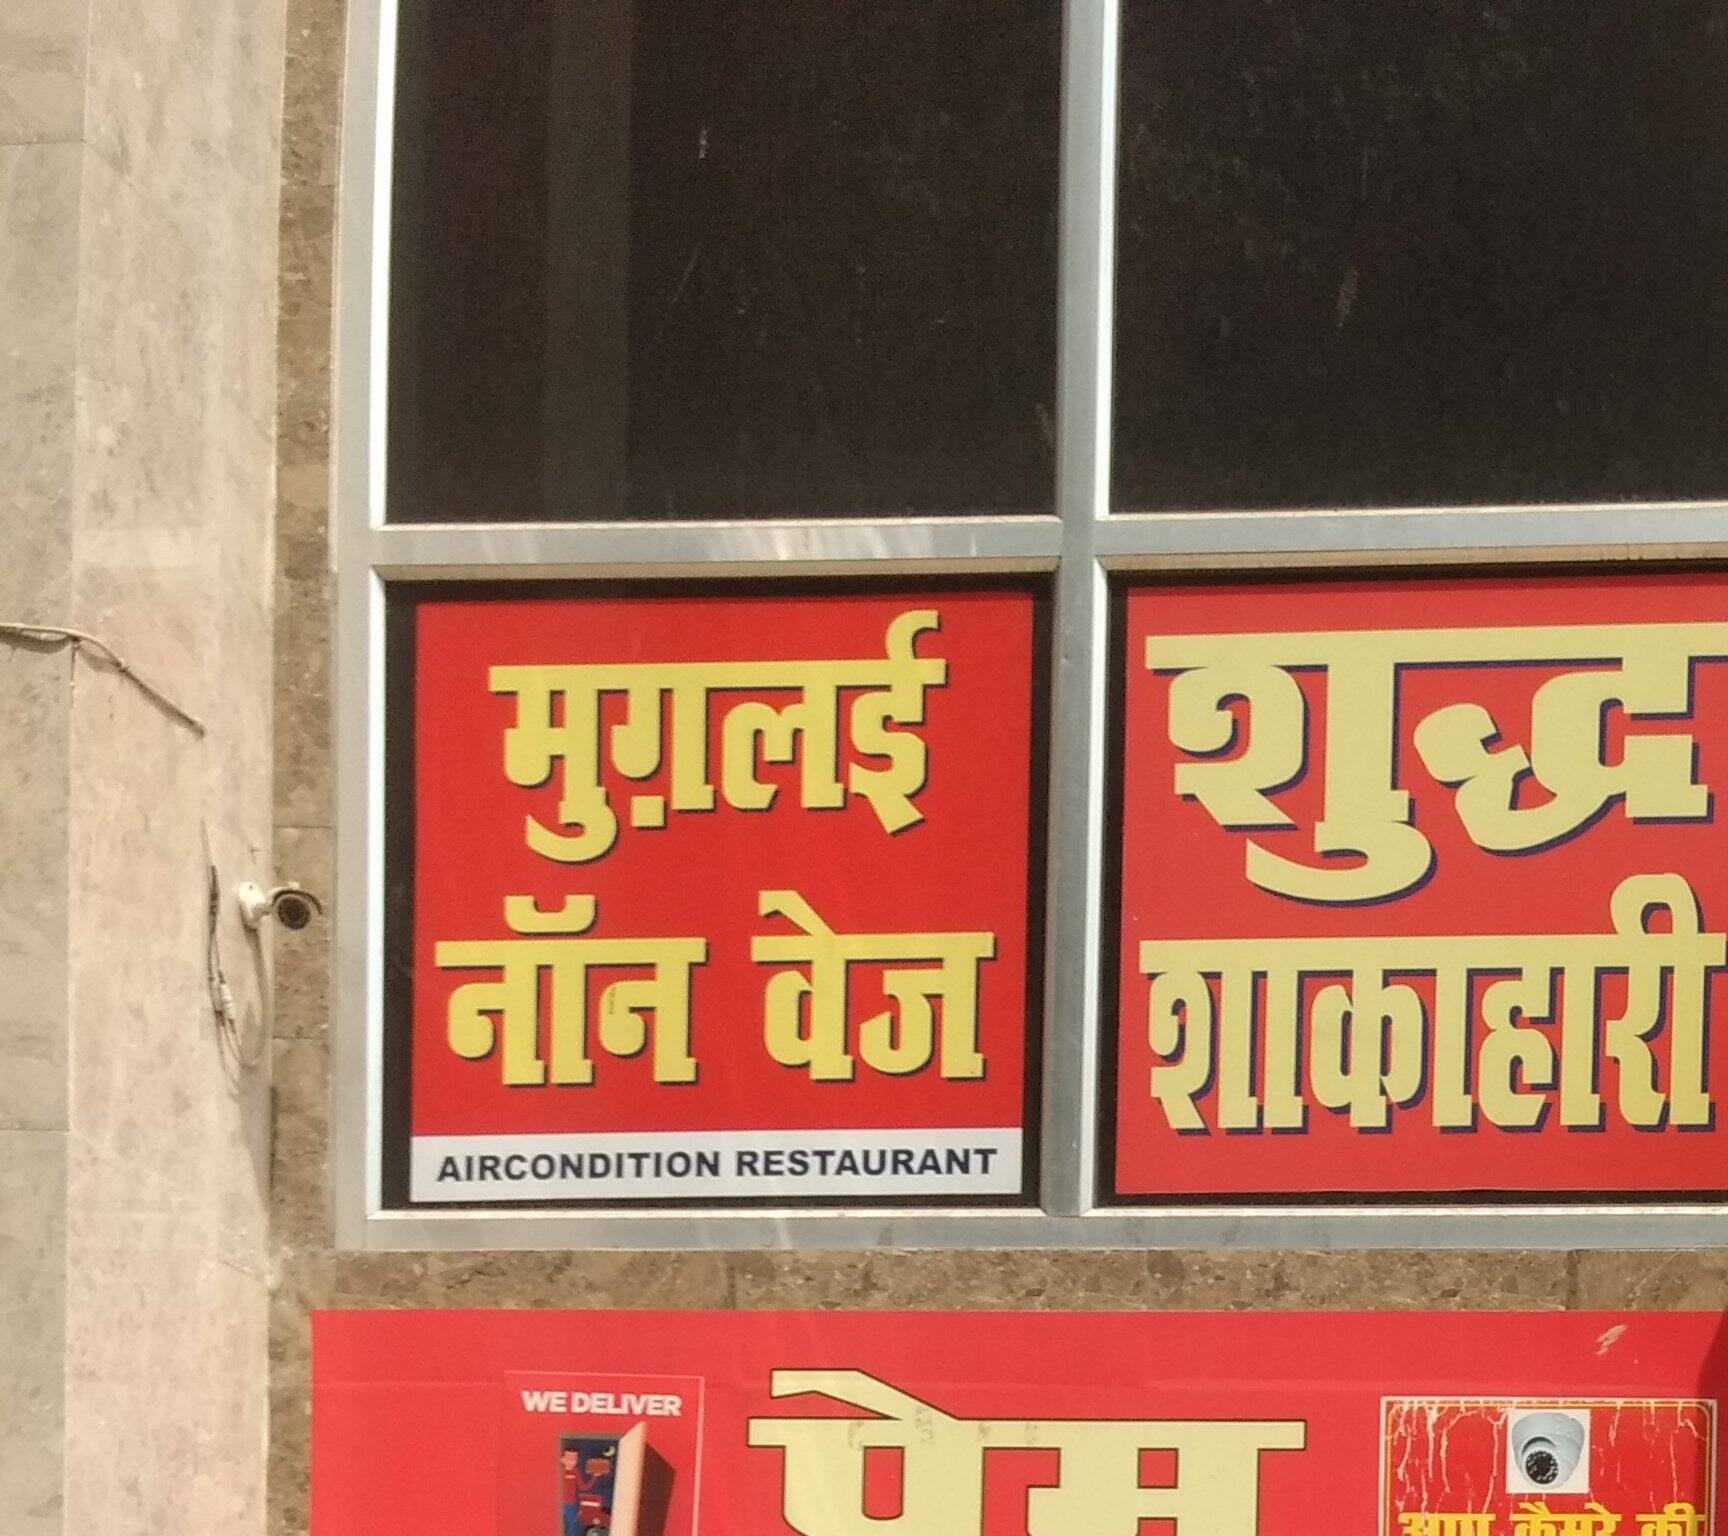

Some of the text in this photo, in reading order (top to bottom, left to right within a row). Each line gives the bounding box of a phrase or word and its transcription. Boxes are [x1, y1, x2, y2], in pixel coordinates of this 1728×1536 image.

[436, 890, 995, 1086] नॉन वेज
[437, 1147, 998, 1182] AIRCONDITION RESTAURANT
[522, 1391, 682, 1417] WE DELIVER
